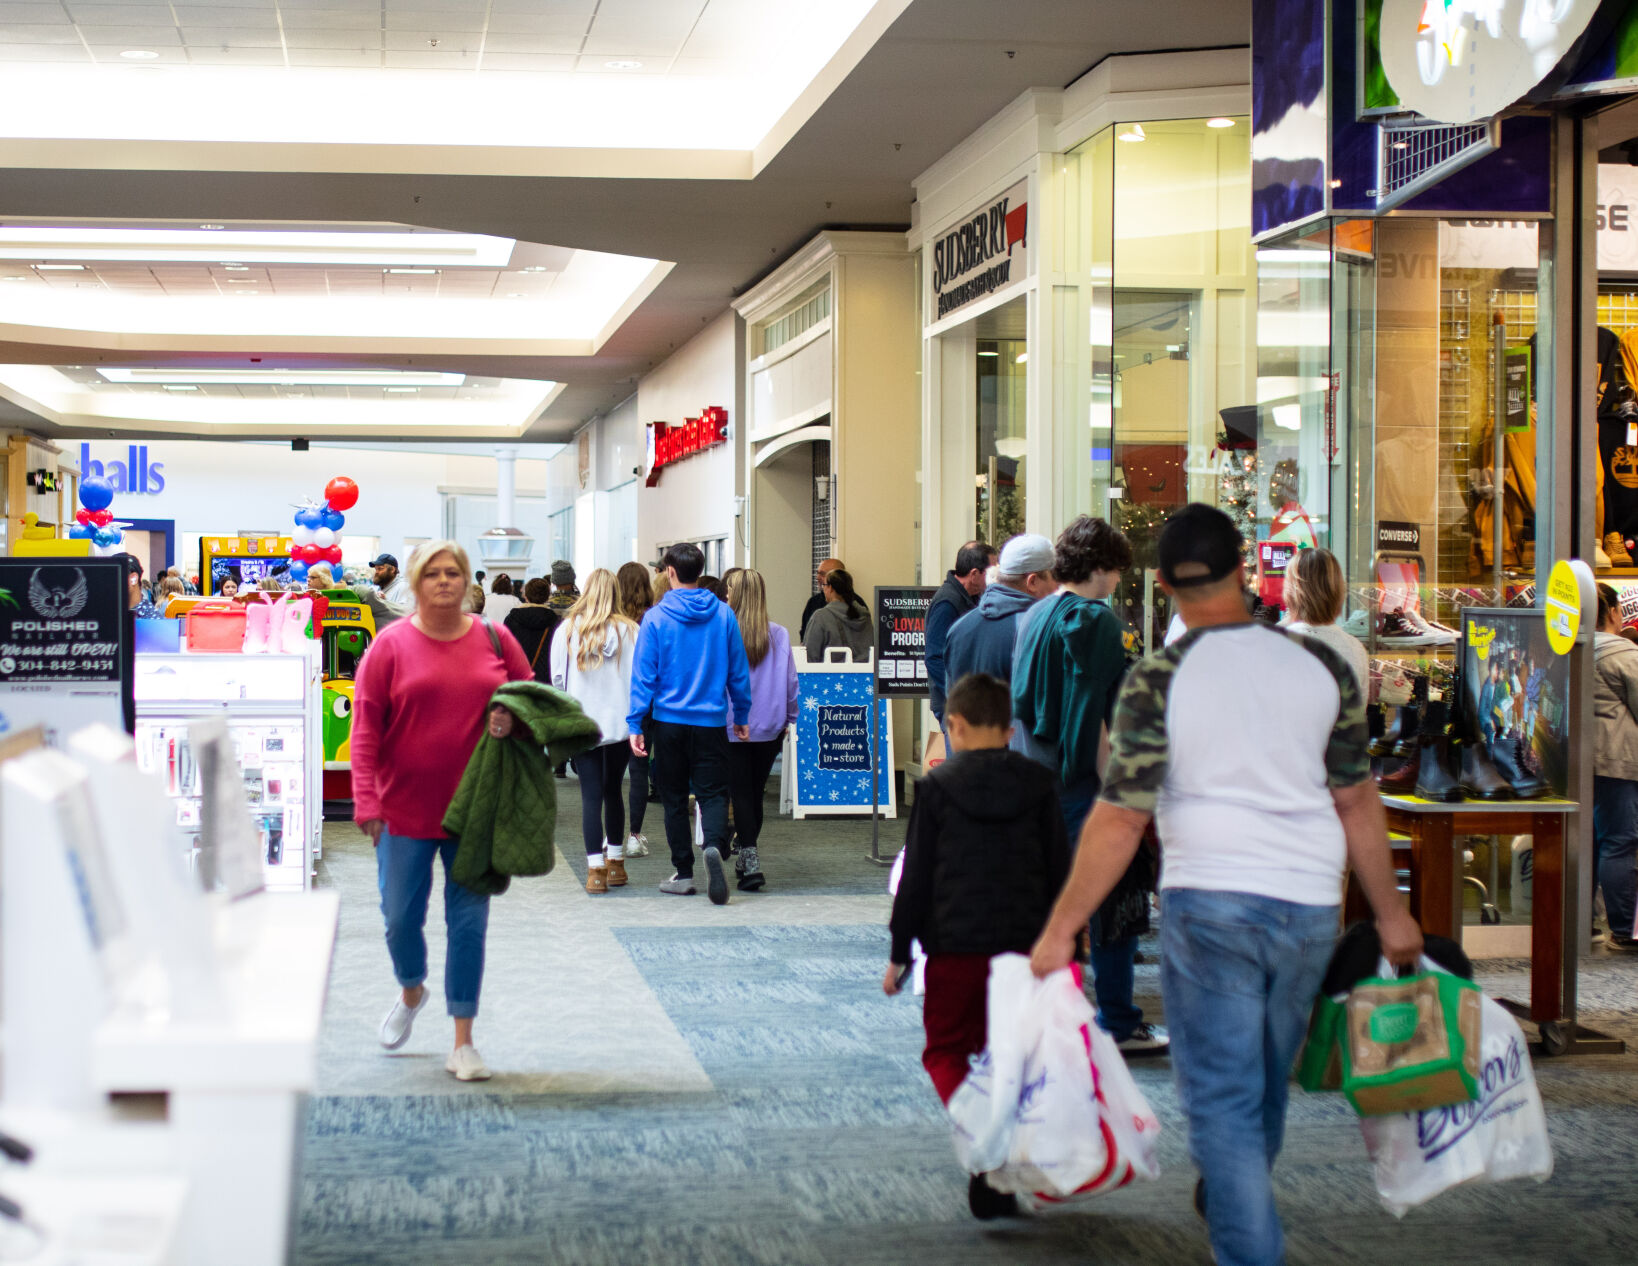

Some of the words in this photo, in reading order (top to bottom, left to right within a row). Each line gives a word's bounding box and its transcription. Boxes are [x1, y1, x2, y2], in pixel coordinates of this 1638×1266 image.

[934, 197, 1009, 294] SUDSBERRY
[77, 443, 165, 494] halls
[1380, 529, 1412, 541] CONVERSE
[12, 622, 99, 631] POLISHED
[891, 632, 926, 646] PROGR
[0, 643, 20, 656] We
[22, 646, 43, 656] are
[44, 643, 69, 656] still
[71, 642, 118, 656] OPEN!
[823, 709, 862, 721] Natural
[822, 723, 865, 736] Products
[832, 738, 855, 750] made
